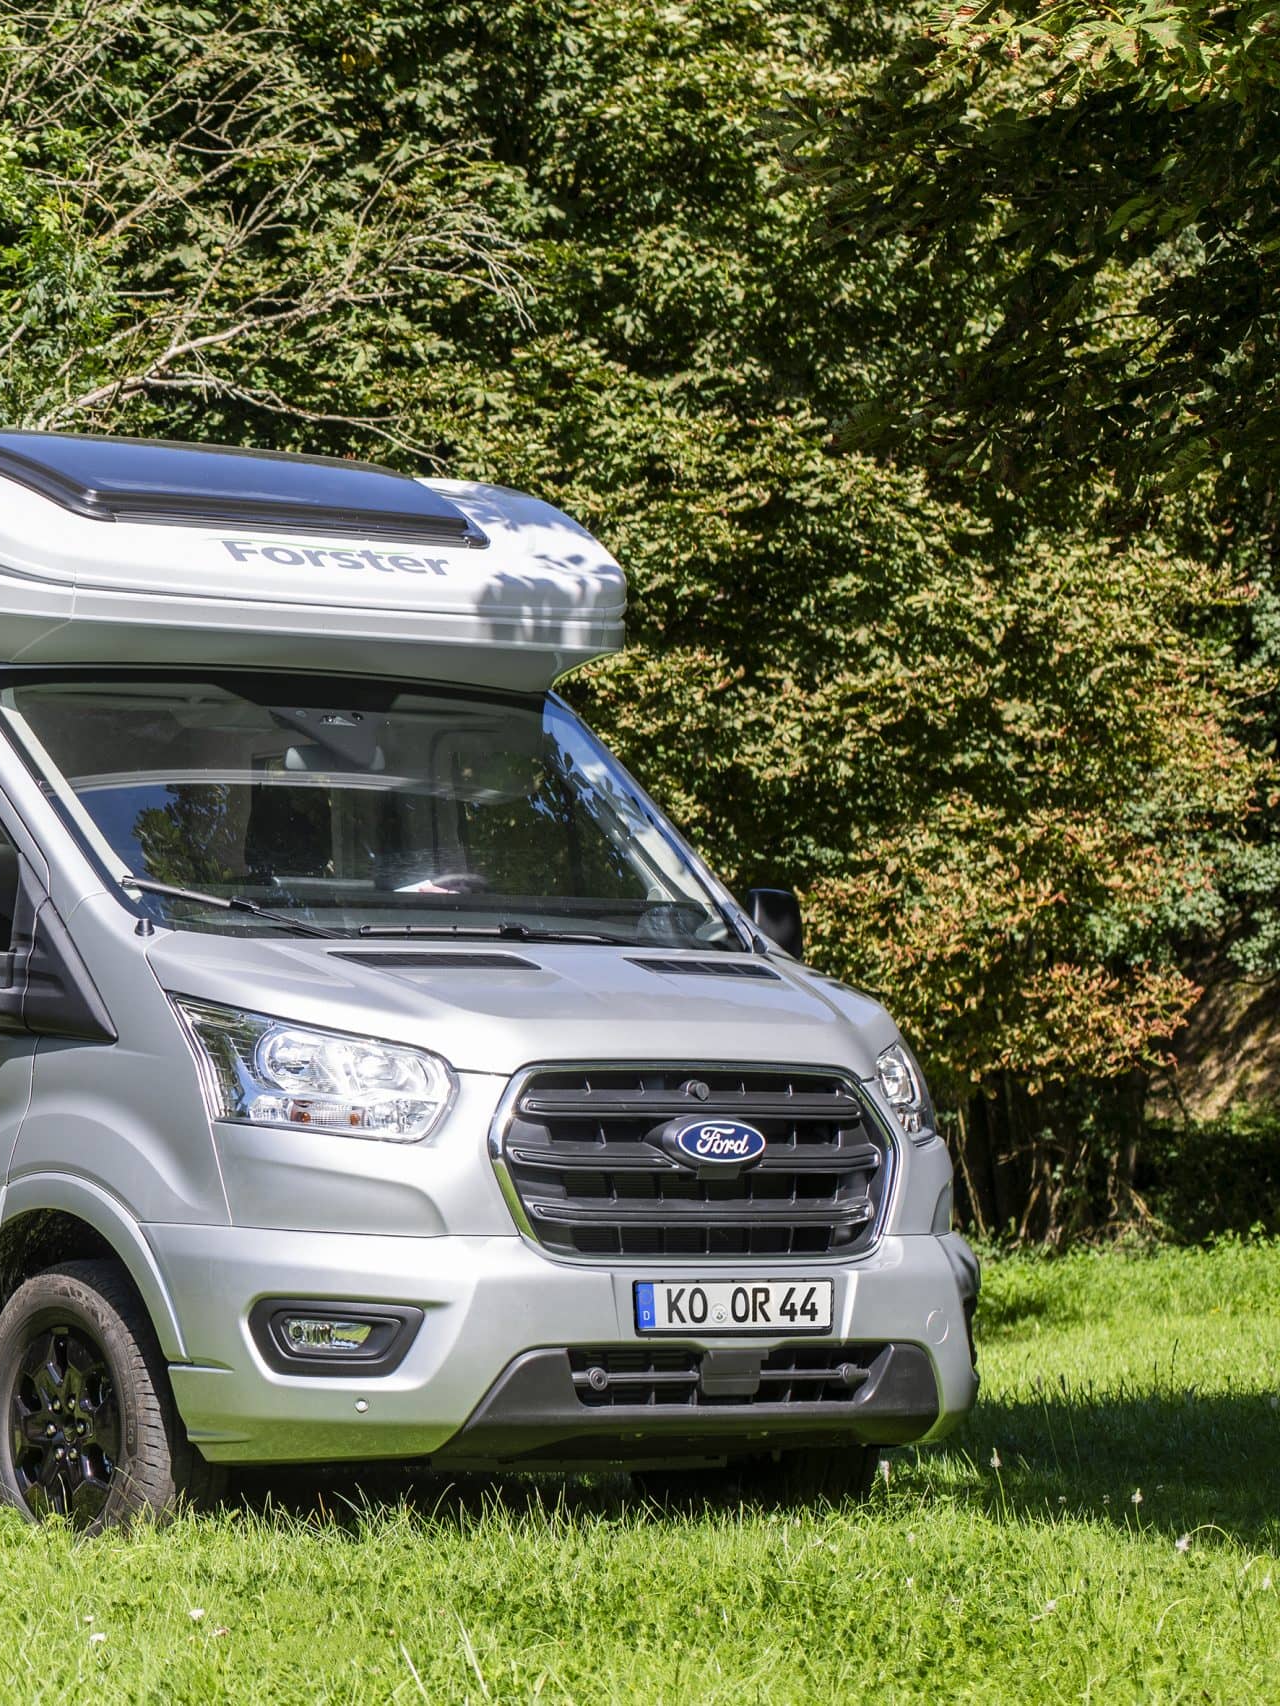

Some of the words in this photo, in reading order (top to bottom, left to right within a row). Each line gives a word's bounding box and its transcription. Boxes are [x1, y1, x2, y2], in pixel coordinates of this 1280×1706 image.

[222, 540, 449, 576] Forster
[696, 1126, 750, 1155] Ford
[643, 1310, 650, 1321] D
[666, 1287, 709, 1324] KO
[730, 1286, 771, 1323] OR
[779, 1286, 818, 1322] 44
